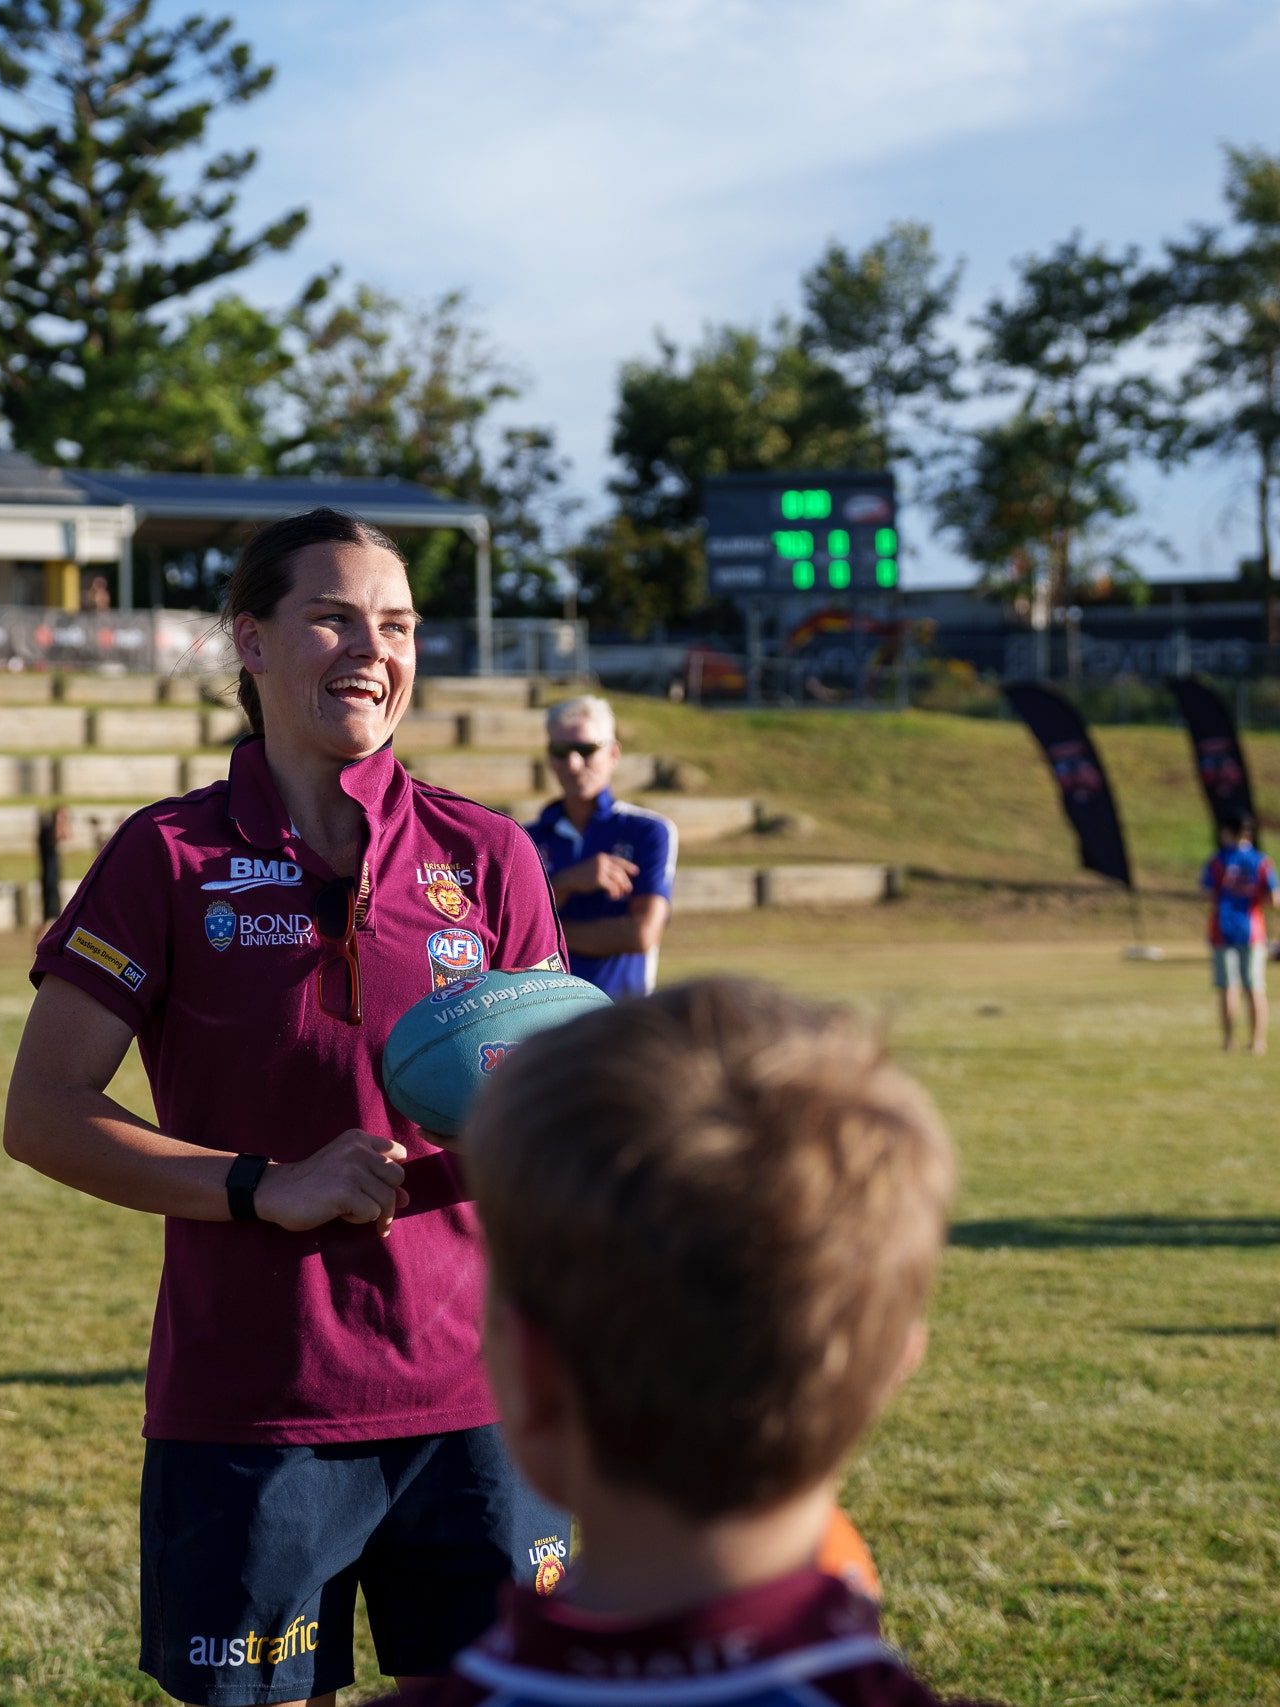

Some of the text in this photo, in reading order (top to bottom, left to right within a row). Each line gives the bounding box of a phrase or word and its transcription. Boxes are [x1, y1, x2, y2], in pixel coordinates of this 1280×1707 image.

[230, 857, 303, 881] BMD
[417, 868, 473, 886] LIONS
[424, 862, 461, 870] BRISBANE
[239, 914, 313, 934] BOND
[240, 932, 314, 946] UNIVERSITY
[434, 937, 479, 962] AFL
[76, 936, 123, 970] Hastings Deering
[124, 966, 141, 984] CAT
[433, 997, 481, 1025] Visit
[534, 1535, 558, 1547] BRISBANE
[528, 1540, 567, 1565] LIONS
[189, 1614, 320, 1667] austraffic
